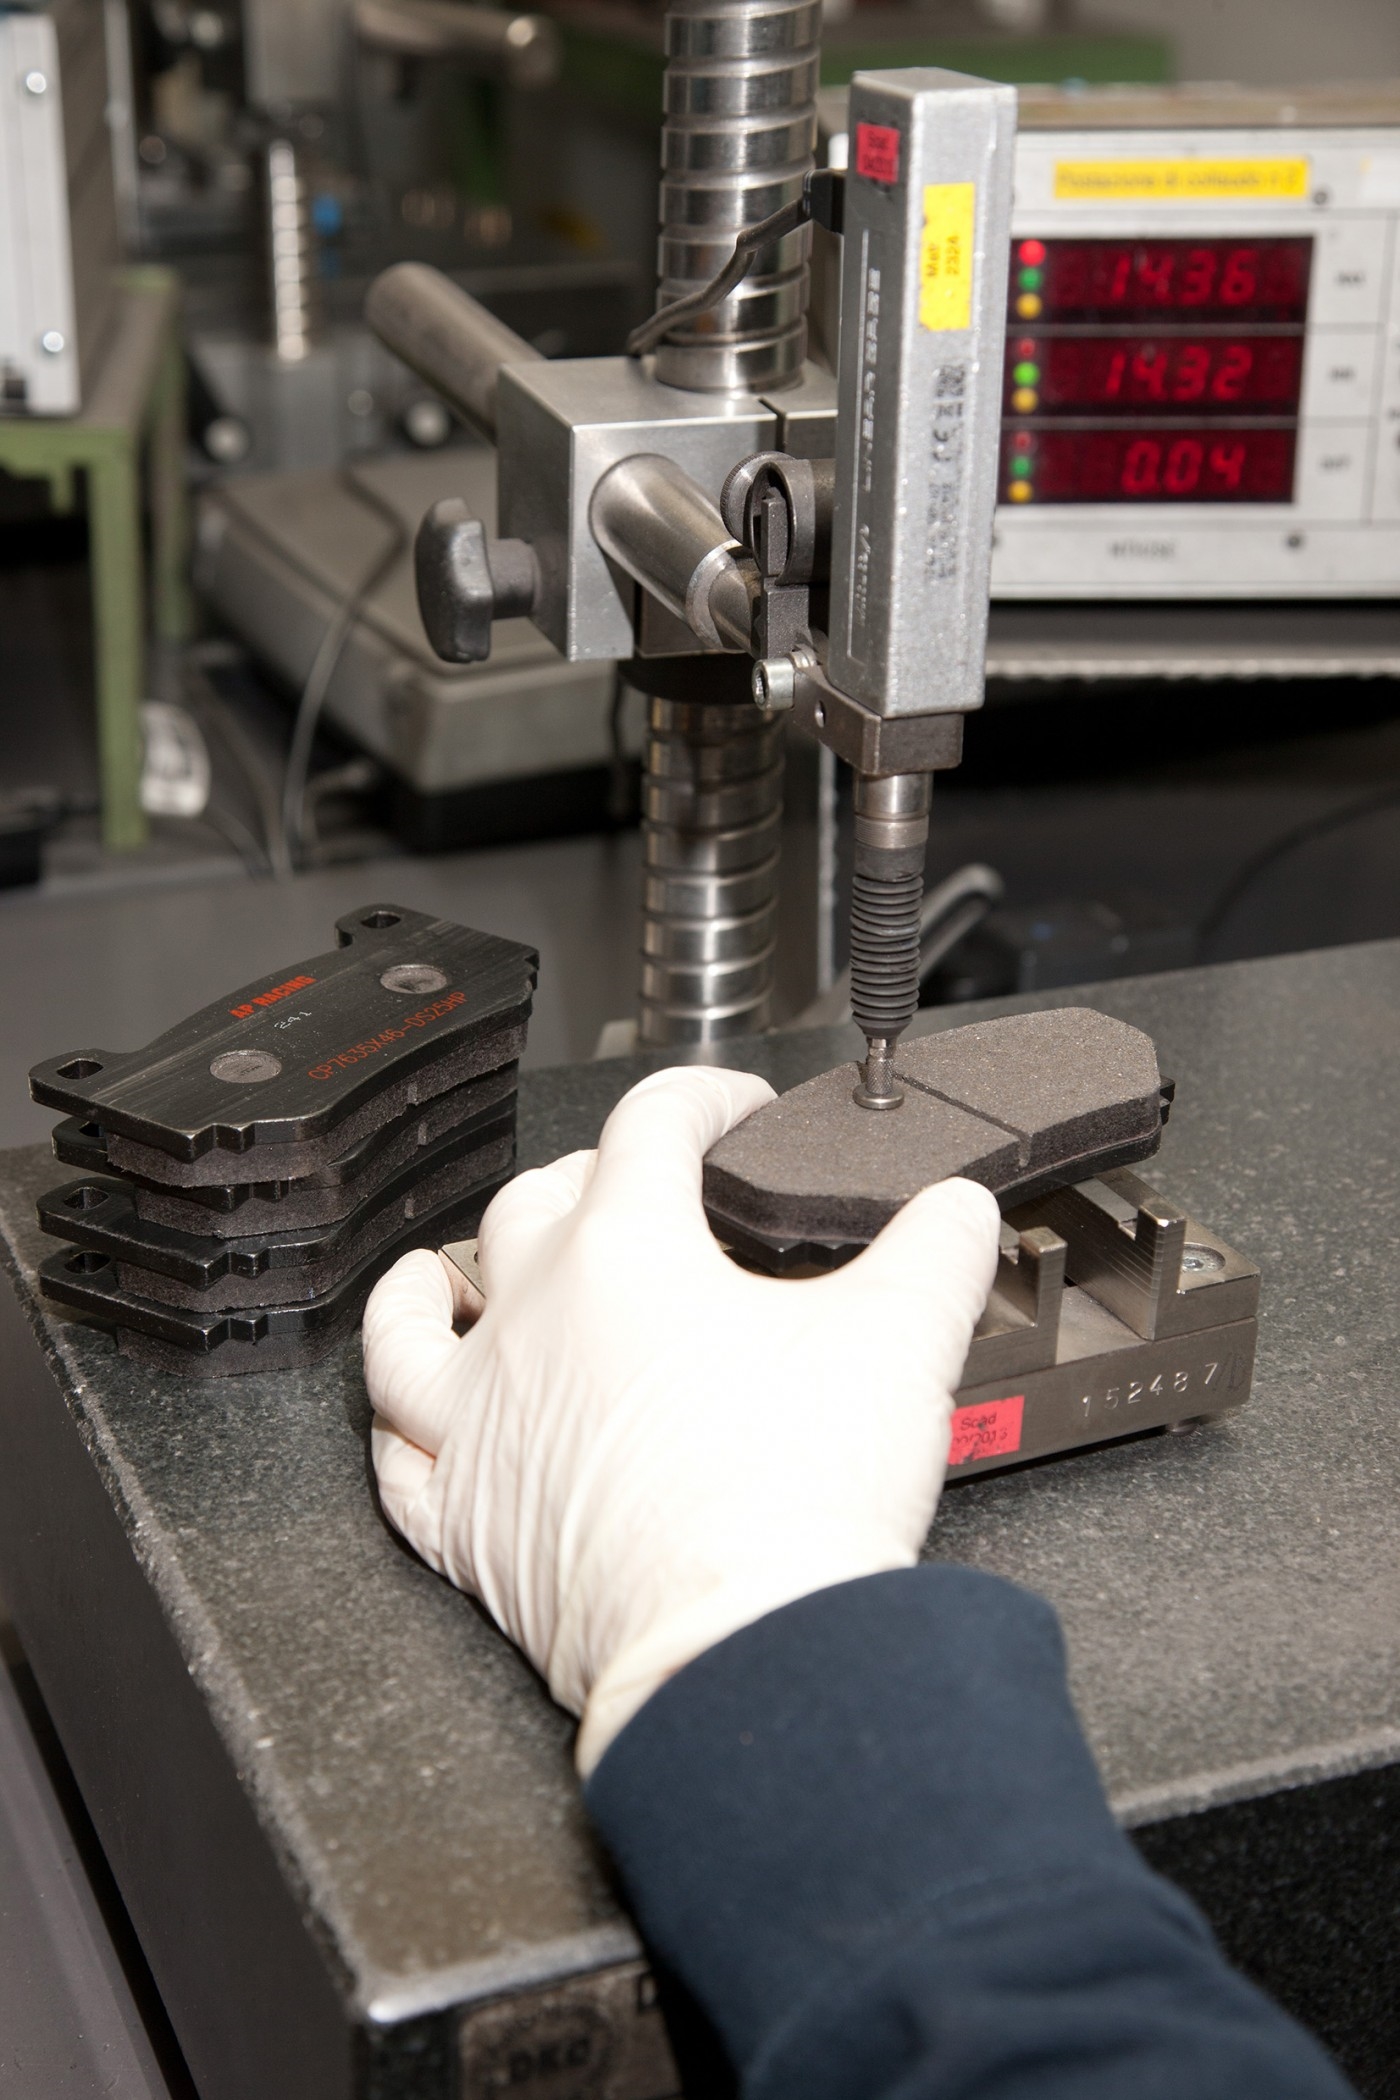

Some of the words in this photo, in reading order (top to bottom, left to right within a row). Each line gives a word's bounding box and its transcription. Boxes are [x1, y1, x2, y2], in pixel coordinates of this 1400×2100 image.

[229, 1003, 254, 1020] AP
[254, 975, 317, 1007] RACING
[307, 991, 468, 1081] CP7635X46-DS25HP
